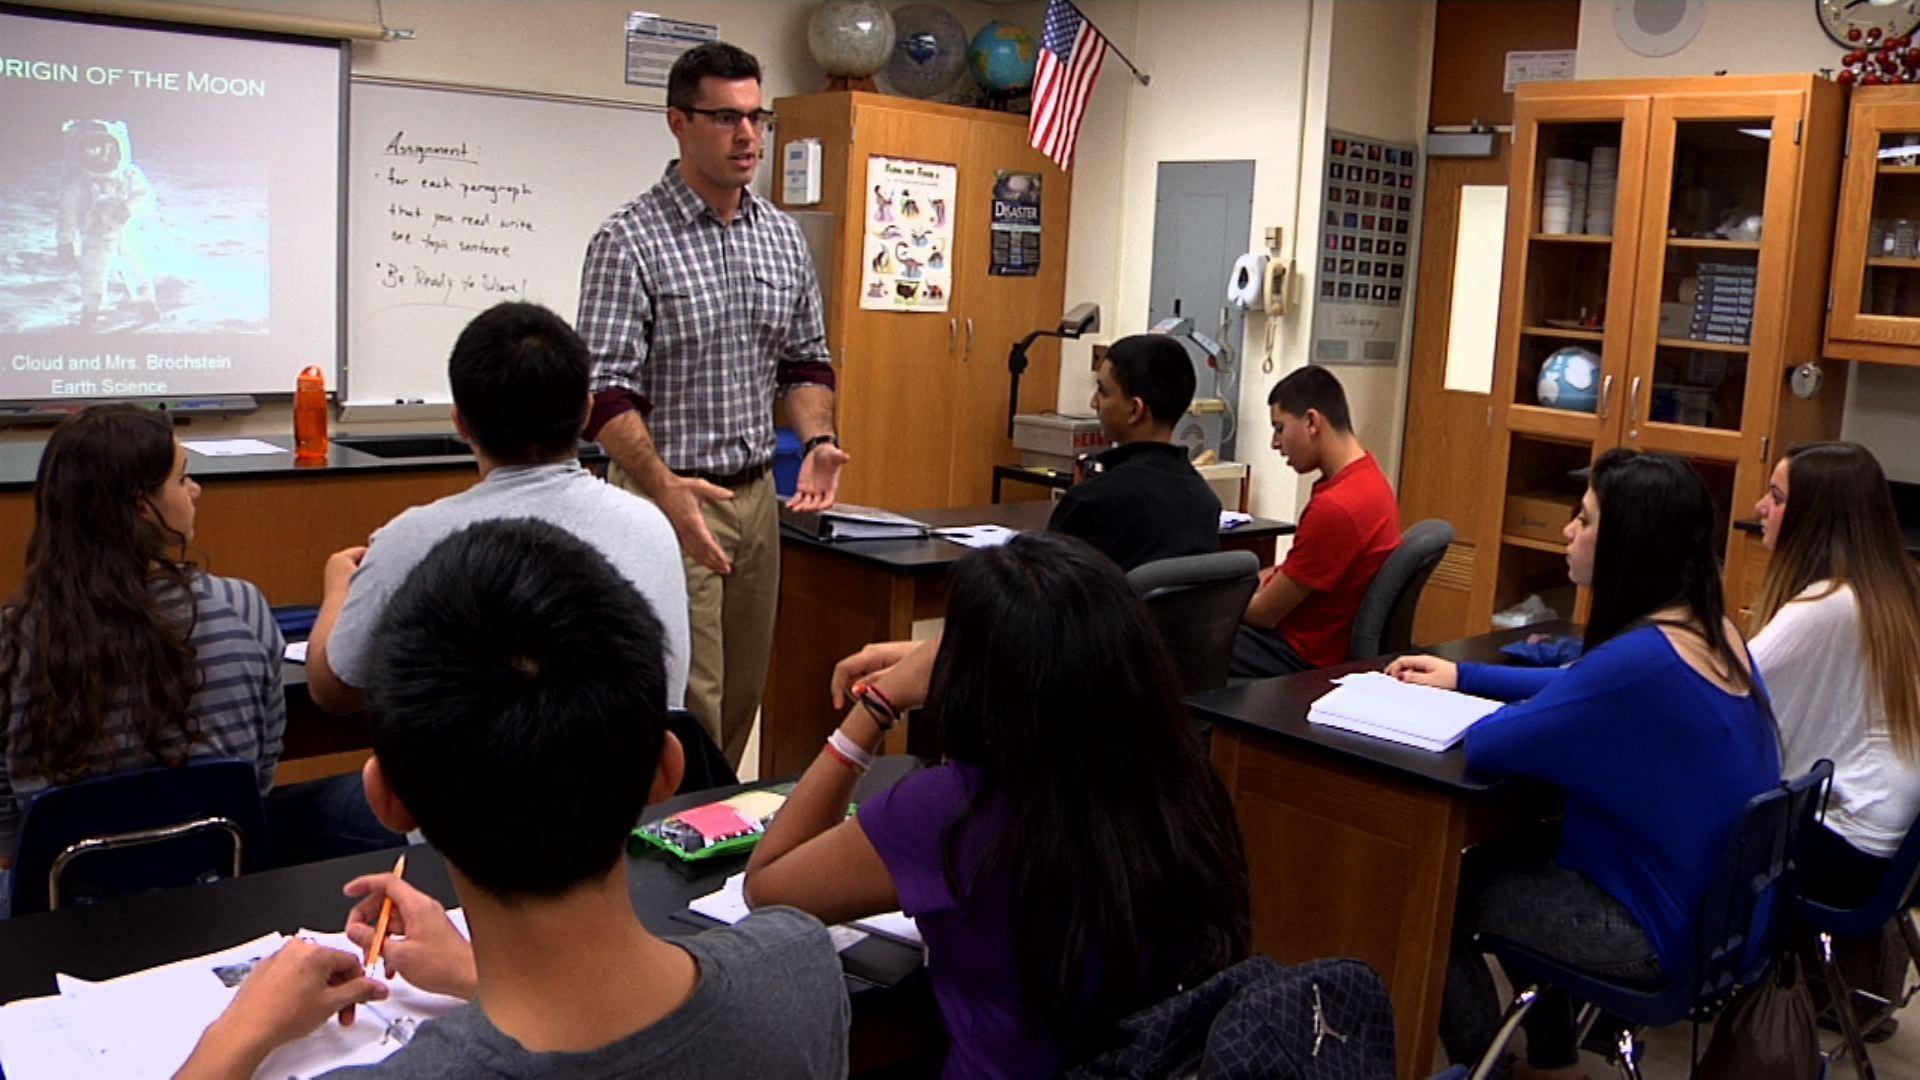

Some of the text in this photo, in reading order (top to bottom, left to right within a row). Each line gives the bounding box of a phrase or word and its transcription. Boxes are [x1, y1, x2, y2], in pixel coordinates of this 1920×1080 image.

[0, 57, 266, 97] RIGIN OF THE MOON
[421, 176, 452, 189] each
[459, 182, 532, 204] paragraph
[388, 202, 421, 218] that
[462, 212, 490, 227] read
[12, 355, 63, 371] Cloud
[68, 355, 101, 370] and
[146, 355, 231, 371] Brochstein
[52, 379, 168, 395] Earth Science
